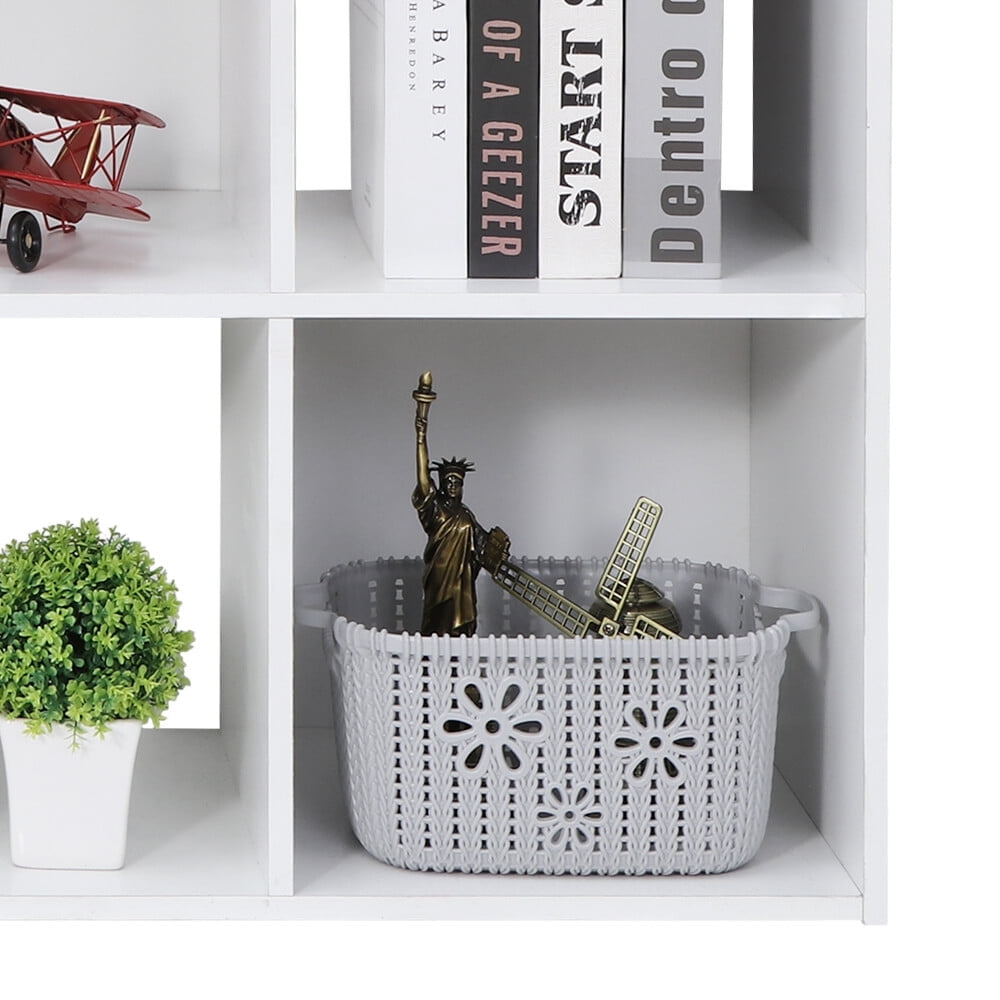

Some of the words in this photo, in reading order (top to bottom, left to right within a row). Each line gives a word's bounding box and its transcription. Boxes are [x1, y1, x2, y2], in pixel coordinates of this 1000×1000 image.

[432, 29, 449, 142] BAREY
[482, 18, 522, 62] OF
[482, 80, 521, 100] A
[481, 121, 524, 256] GEEZER
[558, 28, 604, 228] START
[650, 48, 706, 264] Dentro
